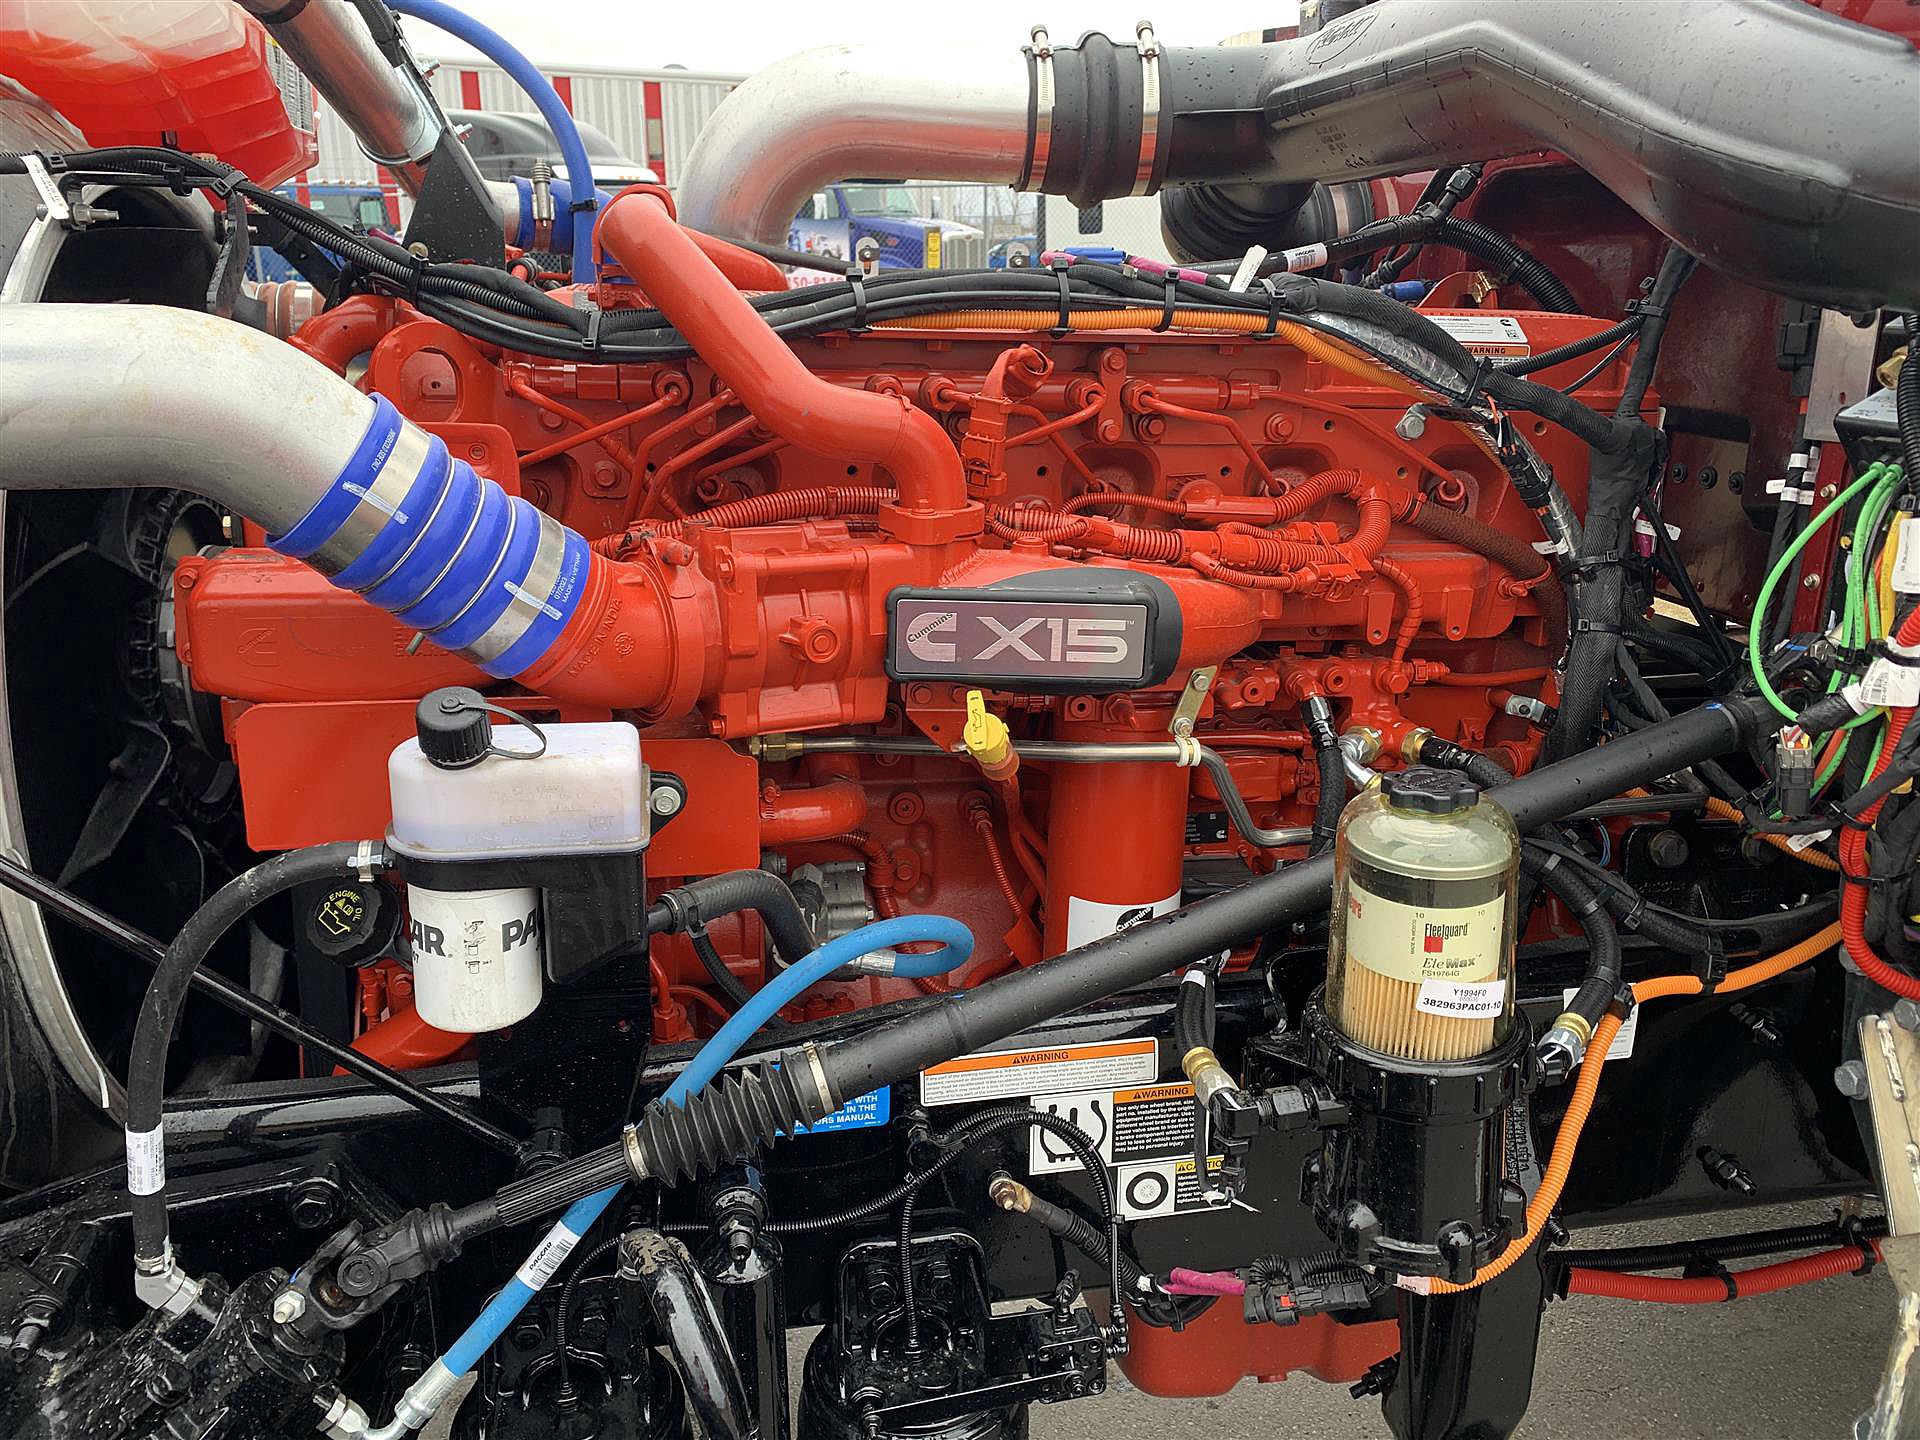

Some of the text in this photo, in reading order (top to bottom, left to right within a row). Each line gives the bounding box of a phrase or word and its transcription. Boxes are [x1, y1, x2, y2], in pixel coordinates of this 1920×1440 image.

[907, 612, 953, 643] Cummins
[568, 646, 599, 678] MADE
[604, 598, 622, 633] INDIA
[972, 616, 1128, 664] X15
[329, 889, 362, 922] ENGINE OIL
[1116, 906, 1153, 932] Cummins
[1424, 922, 1469, 940] Fleetguard
[1421, 970, 1461, 978] FS19764G
[1021, 1051, 1069, 1063] WARNING
[1140, 1087, 1189, 1099] WARNING
[855, 1095, 878, 1105] WITH
[847, 1104, 857, 1113] IN
[859, 1103, 877, 1112] THE
[837, 1113, 876, 1123] MANUAL
[1145, 1113, 1180, 1121] manufacturer.
[1146, 1142, 1168, 1150] personal
